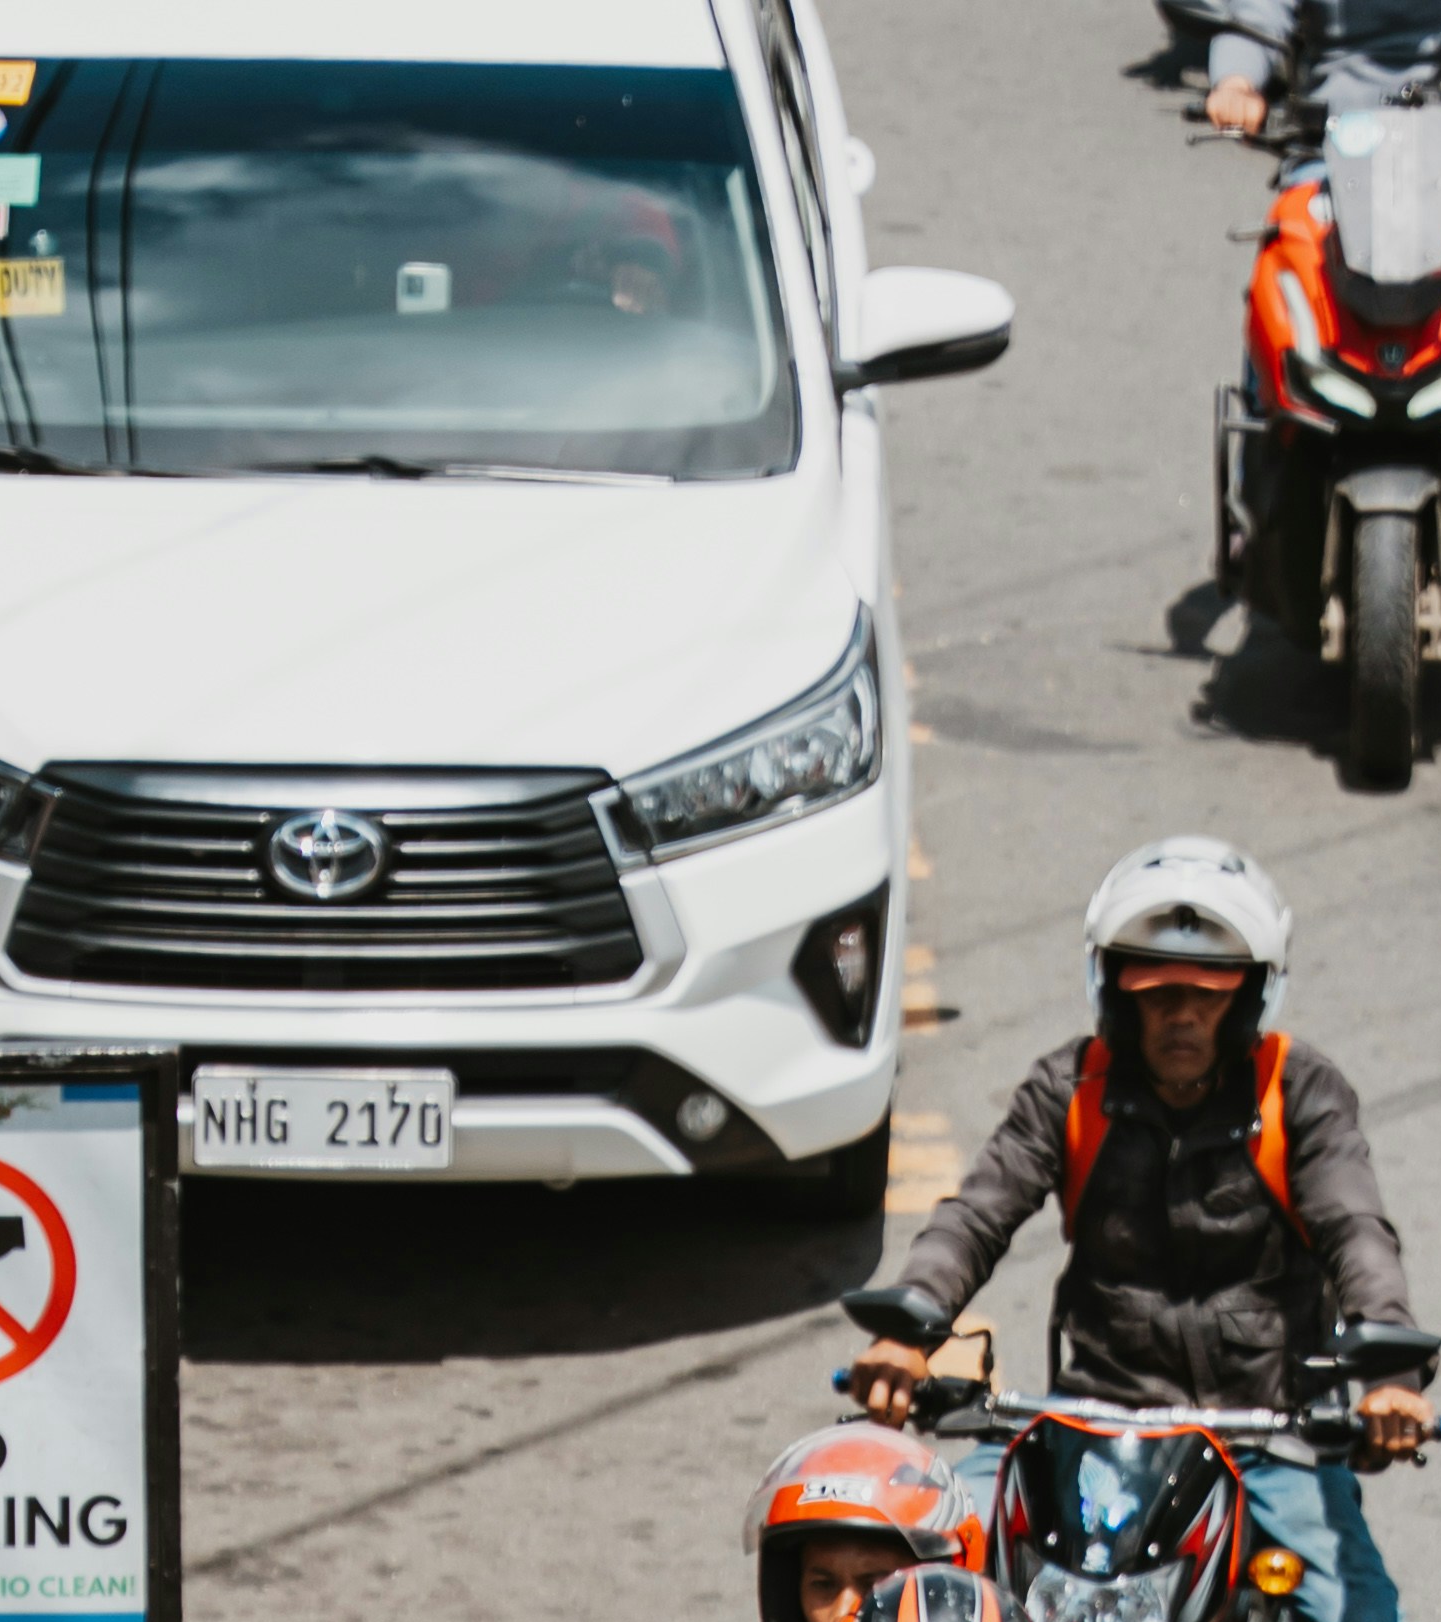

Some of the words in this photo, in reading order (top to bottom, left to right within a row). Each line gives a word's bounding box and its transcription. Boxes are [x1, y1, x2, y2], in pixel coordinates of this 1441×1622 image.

[203, 1098, 288, 1145] NHG
[325, 1100, 443, 1147] 2170
[38, 1575, 136, 1598] CLEAN!
